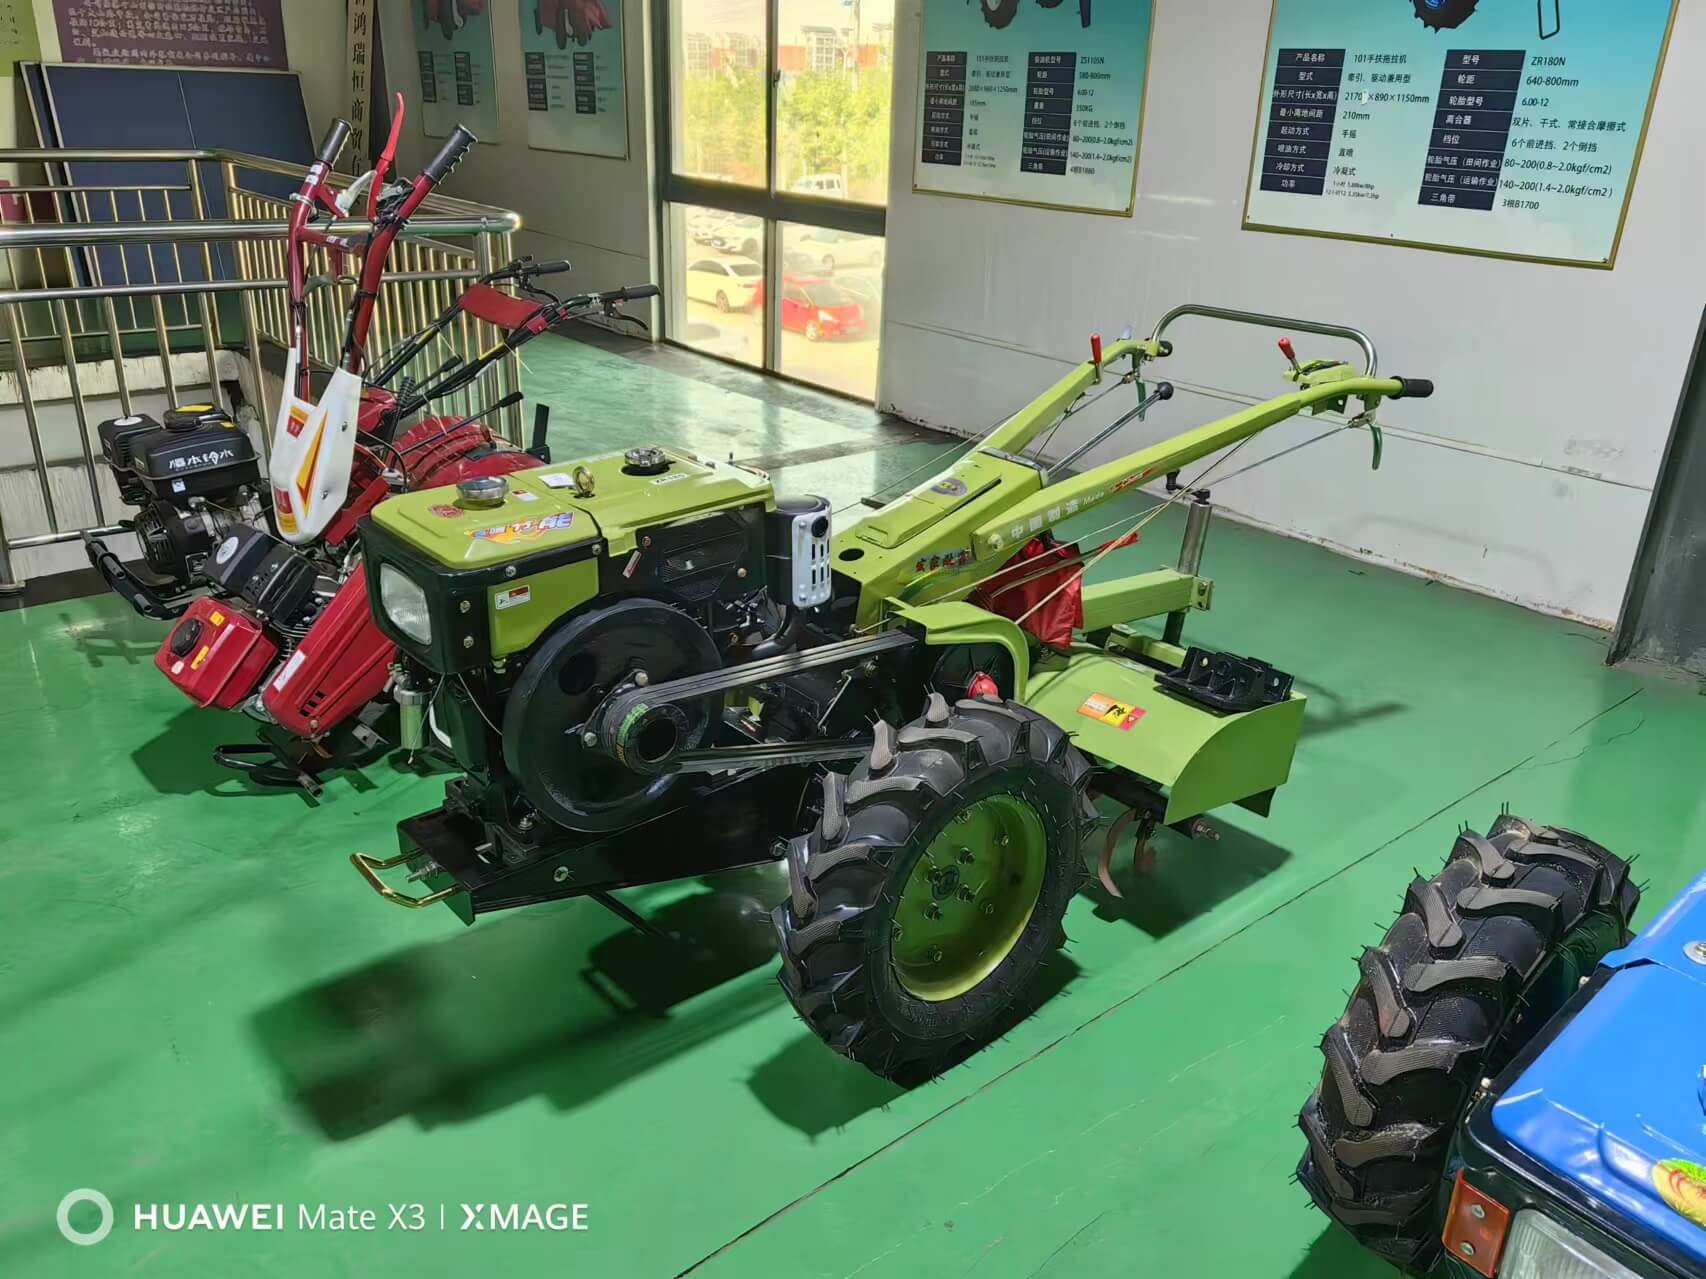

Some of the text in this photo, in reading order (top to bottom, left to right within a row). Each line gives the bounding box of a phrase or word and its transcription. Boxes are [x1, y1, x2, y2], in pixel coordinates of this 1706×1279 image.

[1295, 53, 1326, 63] 产品名称
[1354, 54, 1407, 65] 101手扶拖拉机
[1462, 54, 1480, 65] 型号
[1531, 56, 1566, 67] ZR180N
[1298, 71, 1313, 81] 型式
[1457, 74, 1476, 85] 轮距
[1526, 76, 1579, 87] 640-800mm
[1449, 96, 1484, 107] 轮胎型号
[1521, 98, 1549, 108] 6.00-12
[1342, 111, 1370, 121] 210mm
[1445, 115, 1472, 126] 离合器
[1280, 126, 1310, 136] 起动方式
